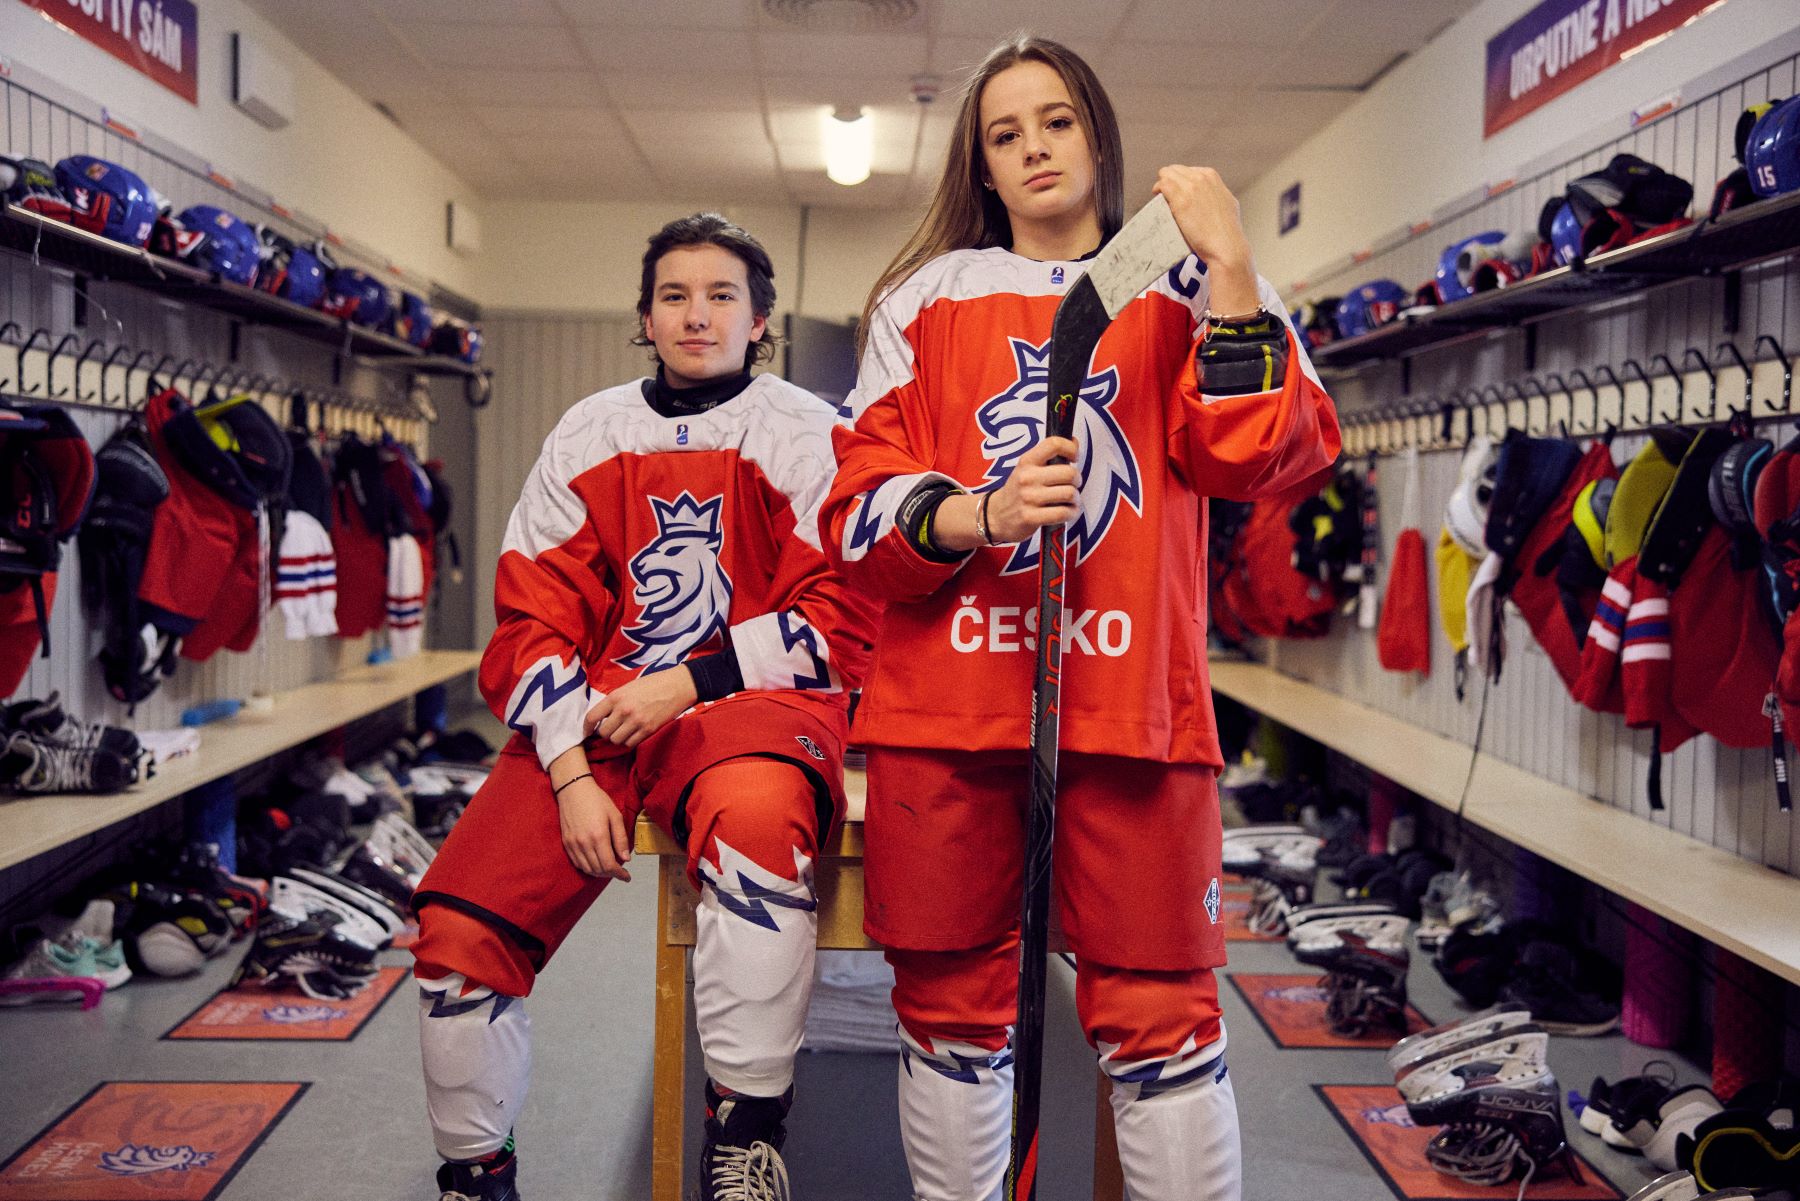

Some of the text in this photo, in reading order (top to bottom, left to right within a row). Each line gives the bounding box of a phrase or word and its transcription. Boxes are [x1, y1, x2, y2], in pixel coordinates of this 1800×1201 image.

[139, 1, 182, 73] SÁM
[1757, 165, 1776, 188] 15
[1029, 690, 1038, 748] BAUER
